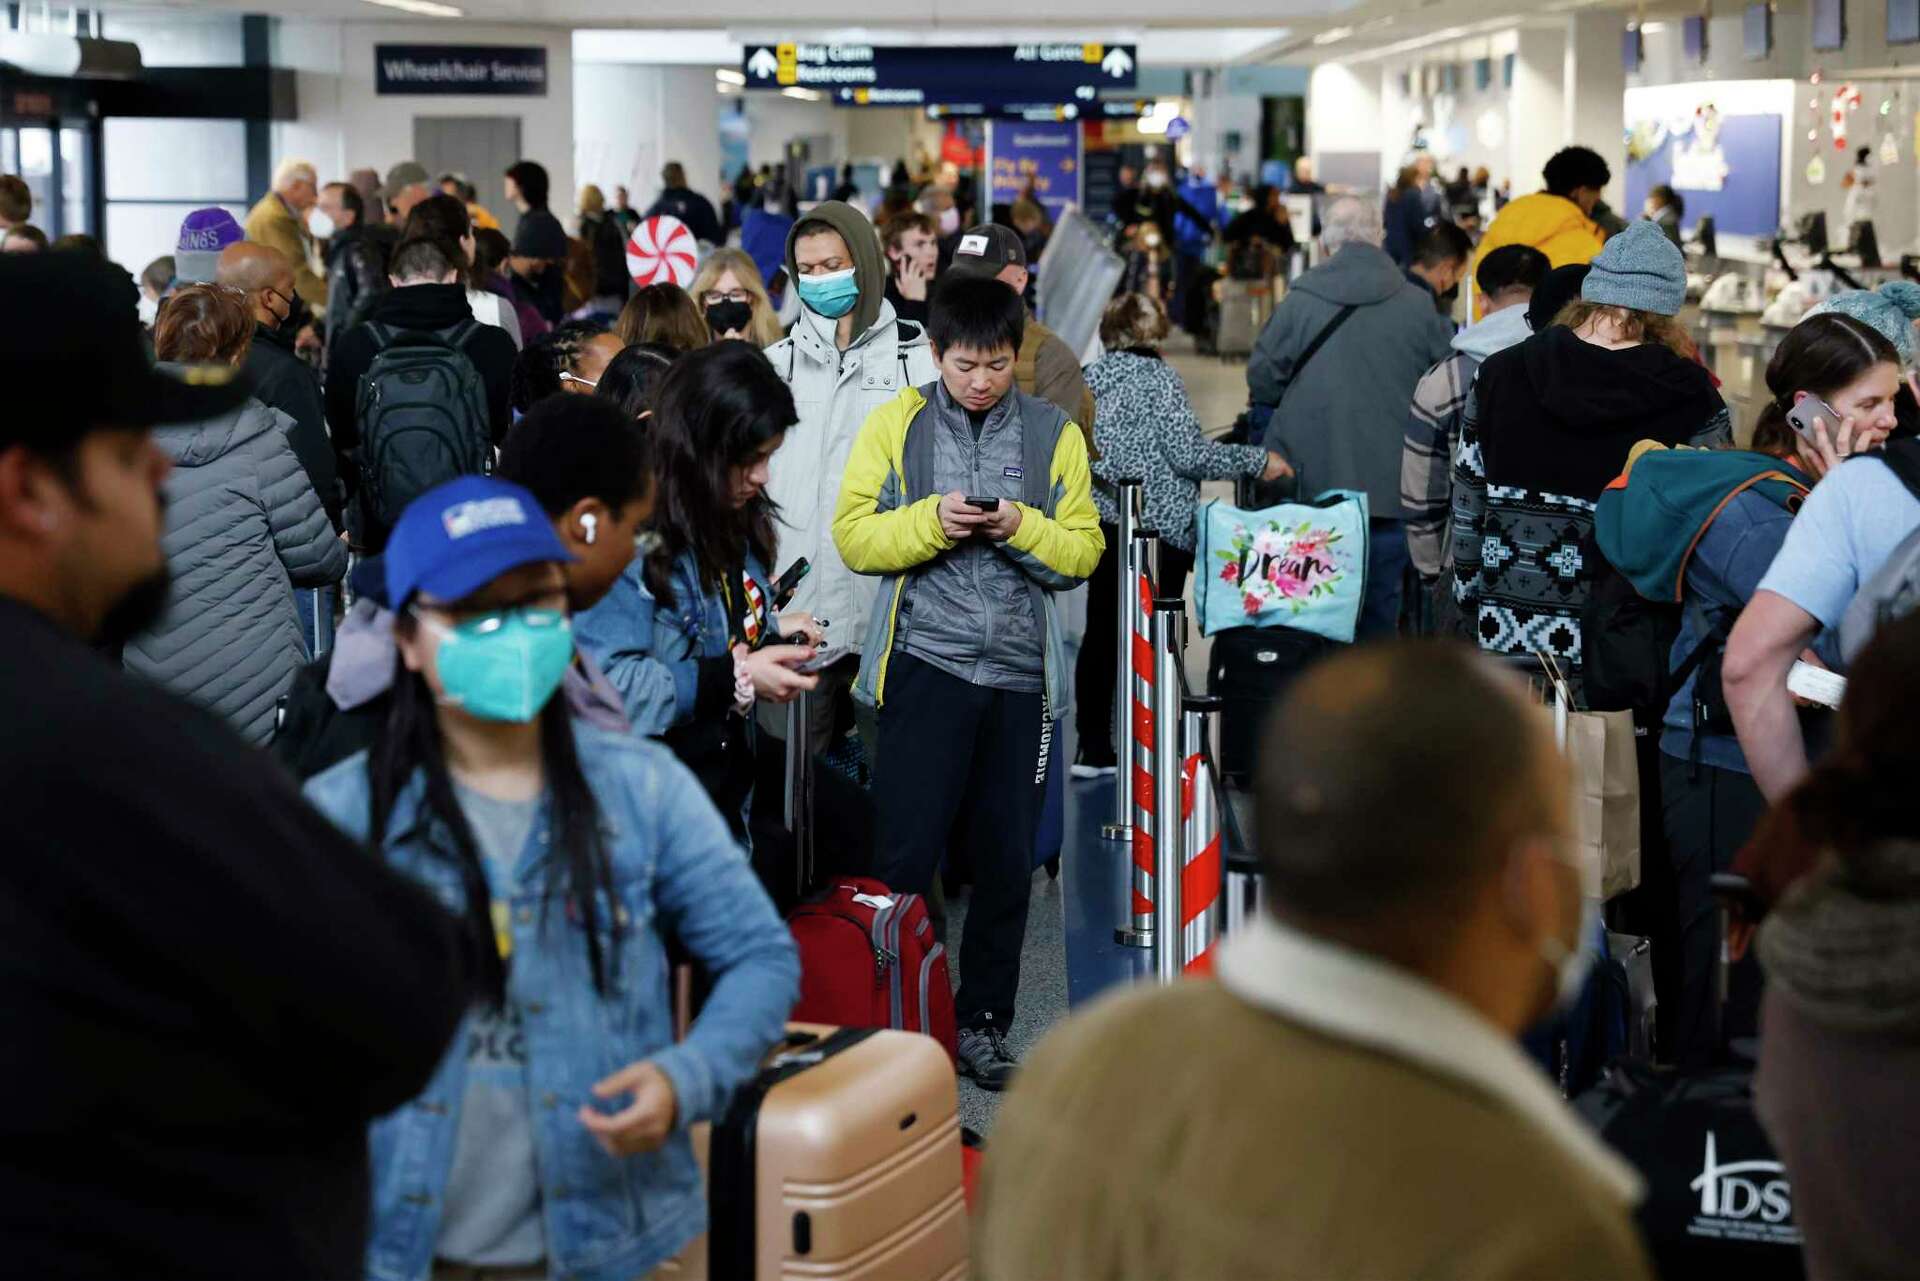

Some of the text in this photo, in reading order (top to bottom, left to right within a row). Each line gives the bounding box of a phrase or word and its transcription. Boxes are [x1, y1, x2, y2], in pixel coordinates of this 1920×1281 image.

[383, 59, 488, 81] Wheelchair
[797, 64, 877, 83] Restrooms
[1236, 546, 1337, 589] Dream
[1034, 693, 1054, 784] RCROMBIE
